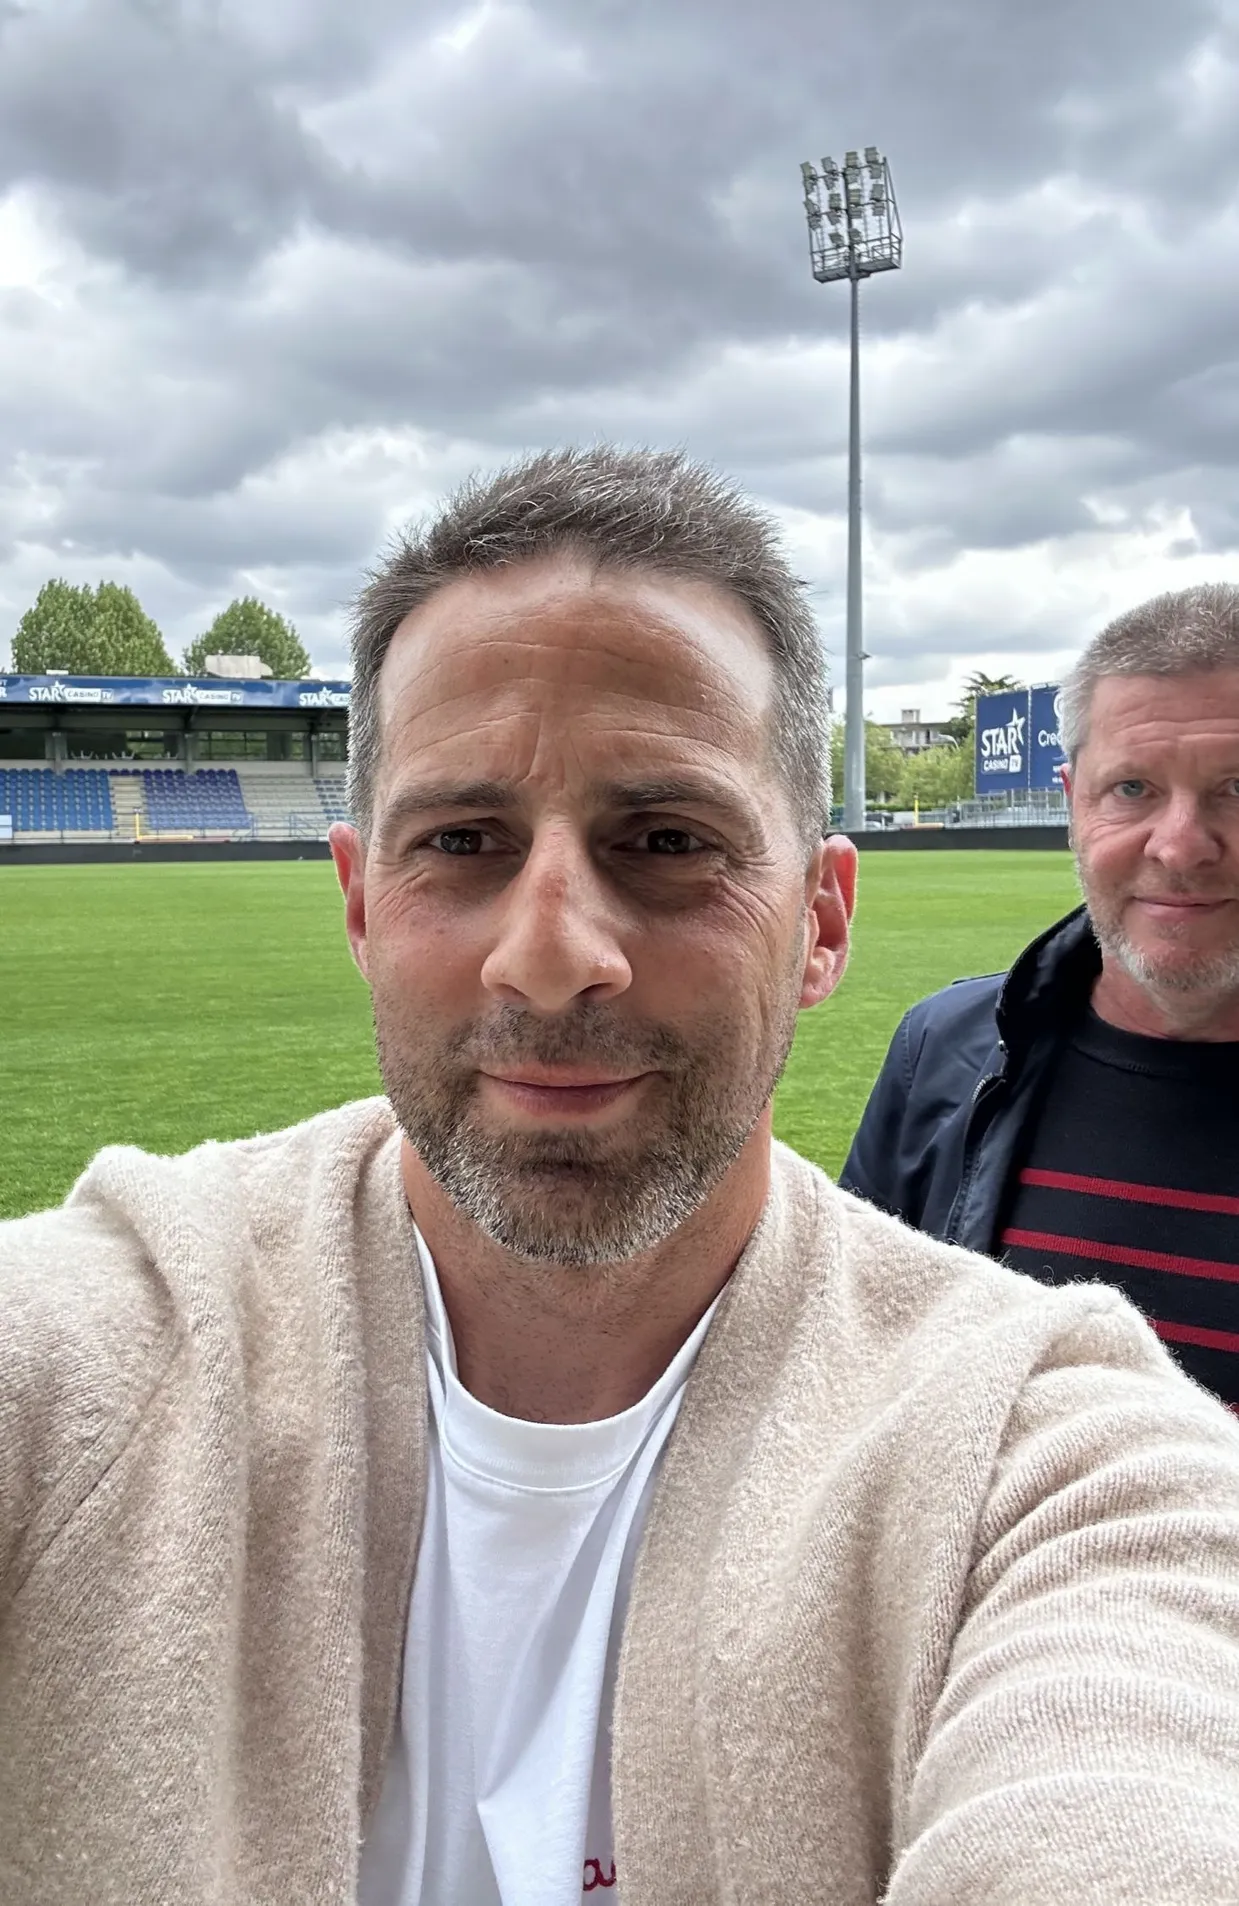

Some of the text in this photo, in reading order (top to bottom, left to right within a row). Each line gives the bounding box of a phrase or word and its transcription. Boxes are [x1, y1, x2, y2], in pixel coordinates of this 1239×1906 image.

[28, 686, 63, 702] STAR
[67, 689, 99, 698] CASINO
[162, 689, 193, 704] STAR
[299, 692, 330, 706] STAR
[981, 727, 1020, 757] STAR
[983, 758, 1008, 772] CASINO
